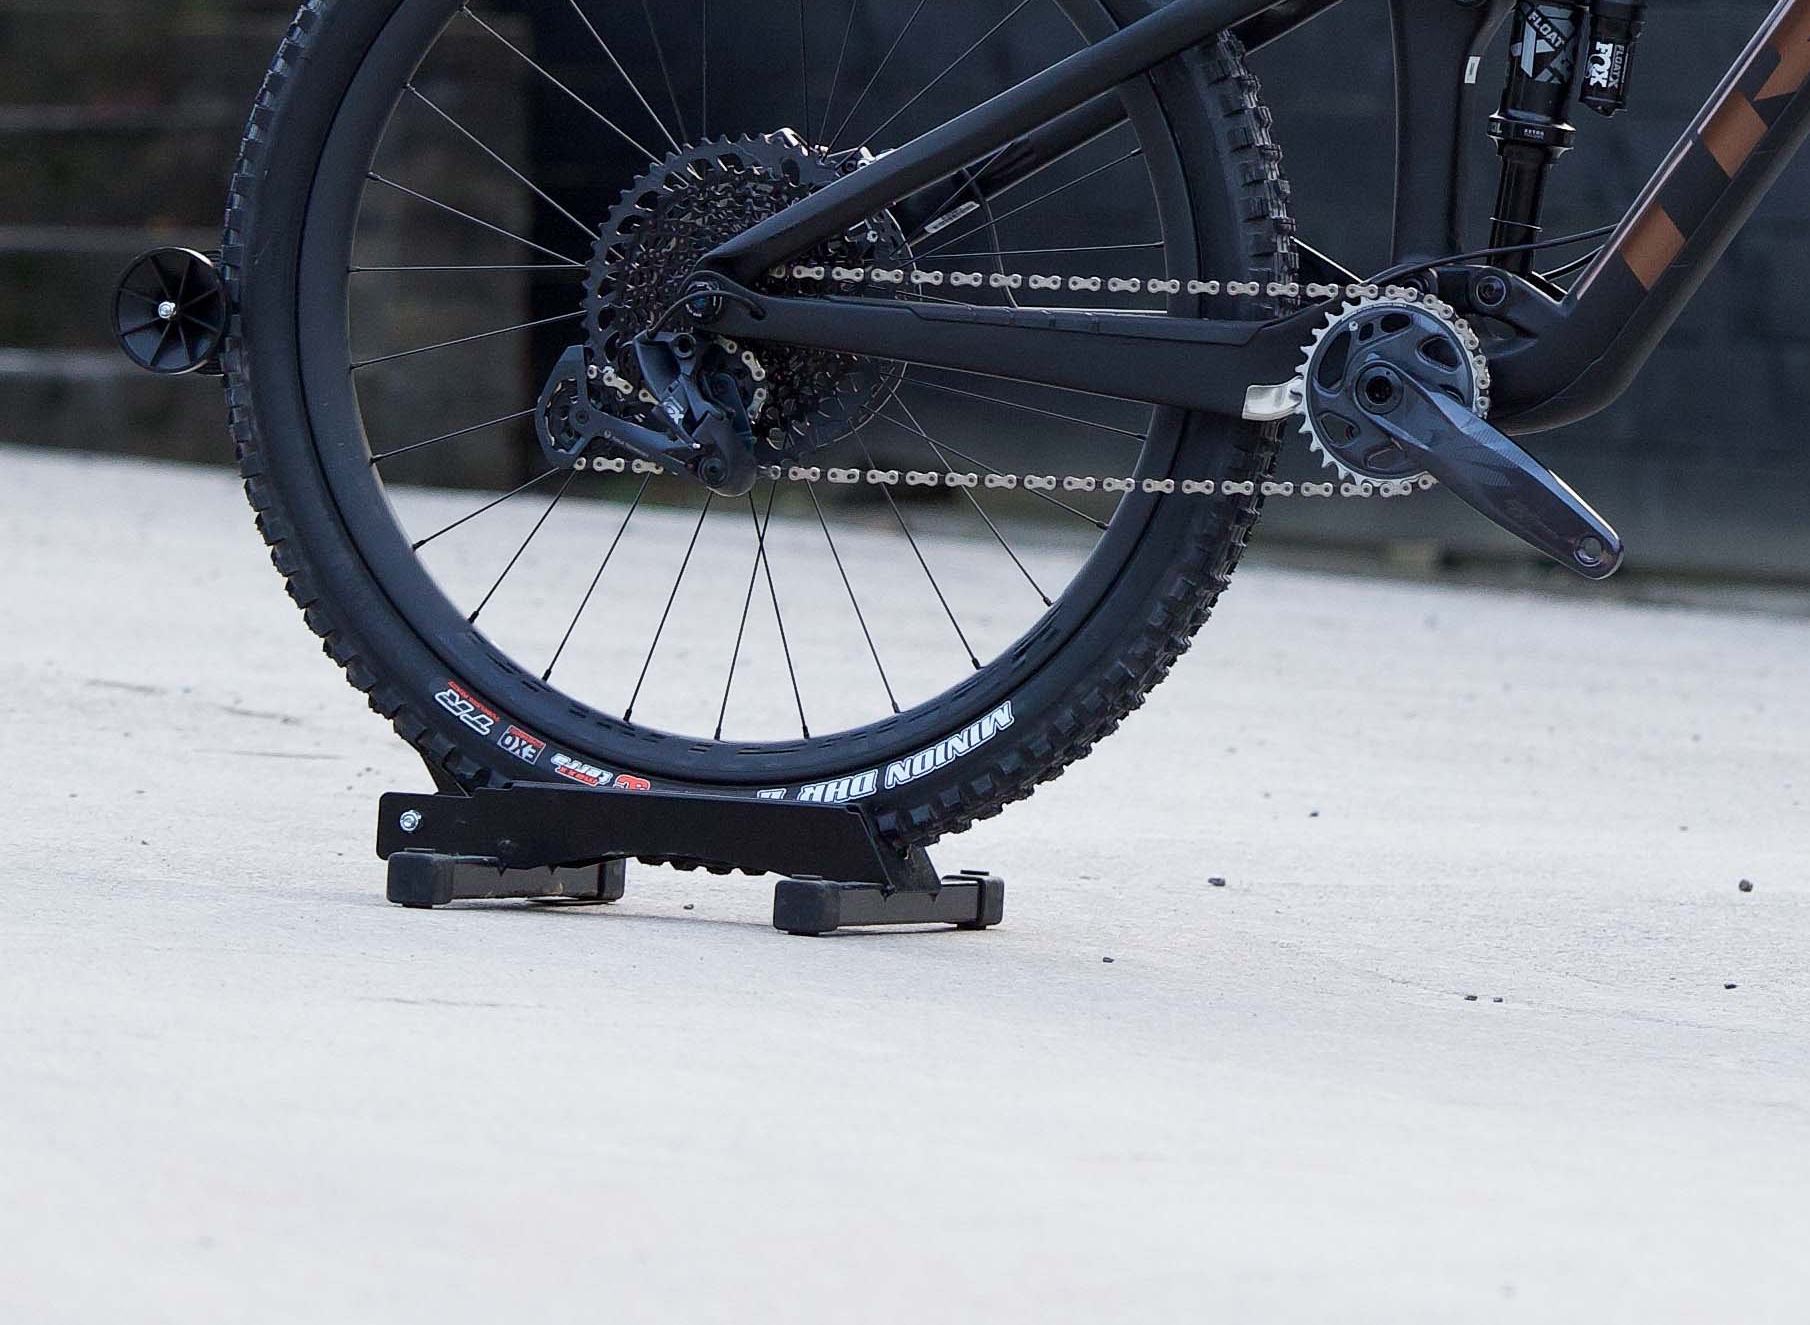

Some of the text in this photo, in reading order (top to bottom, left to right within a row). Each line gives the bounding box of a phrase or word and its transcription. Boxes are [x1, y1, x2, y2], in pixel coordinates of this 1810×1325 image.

[1528, 11, 1565, 47] FLOAT
[1588, 41, 1613, 88] FOX
[435, 689, 495, 735] TR
[499, 731, 539, 765] EXO
[797, 700, 1015, 803] MINION DHR
